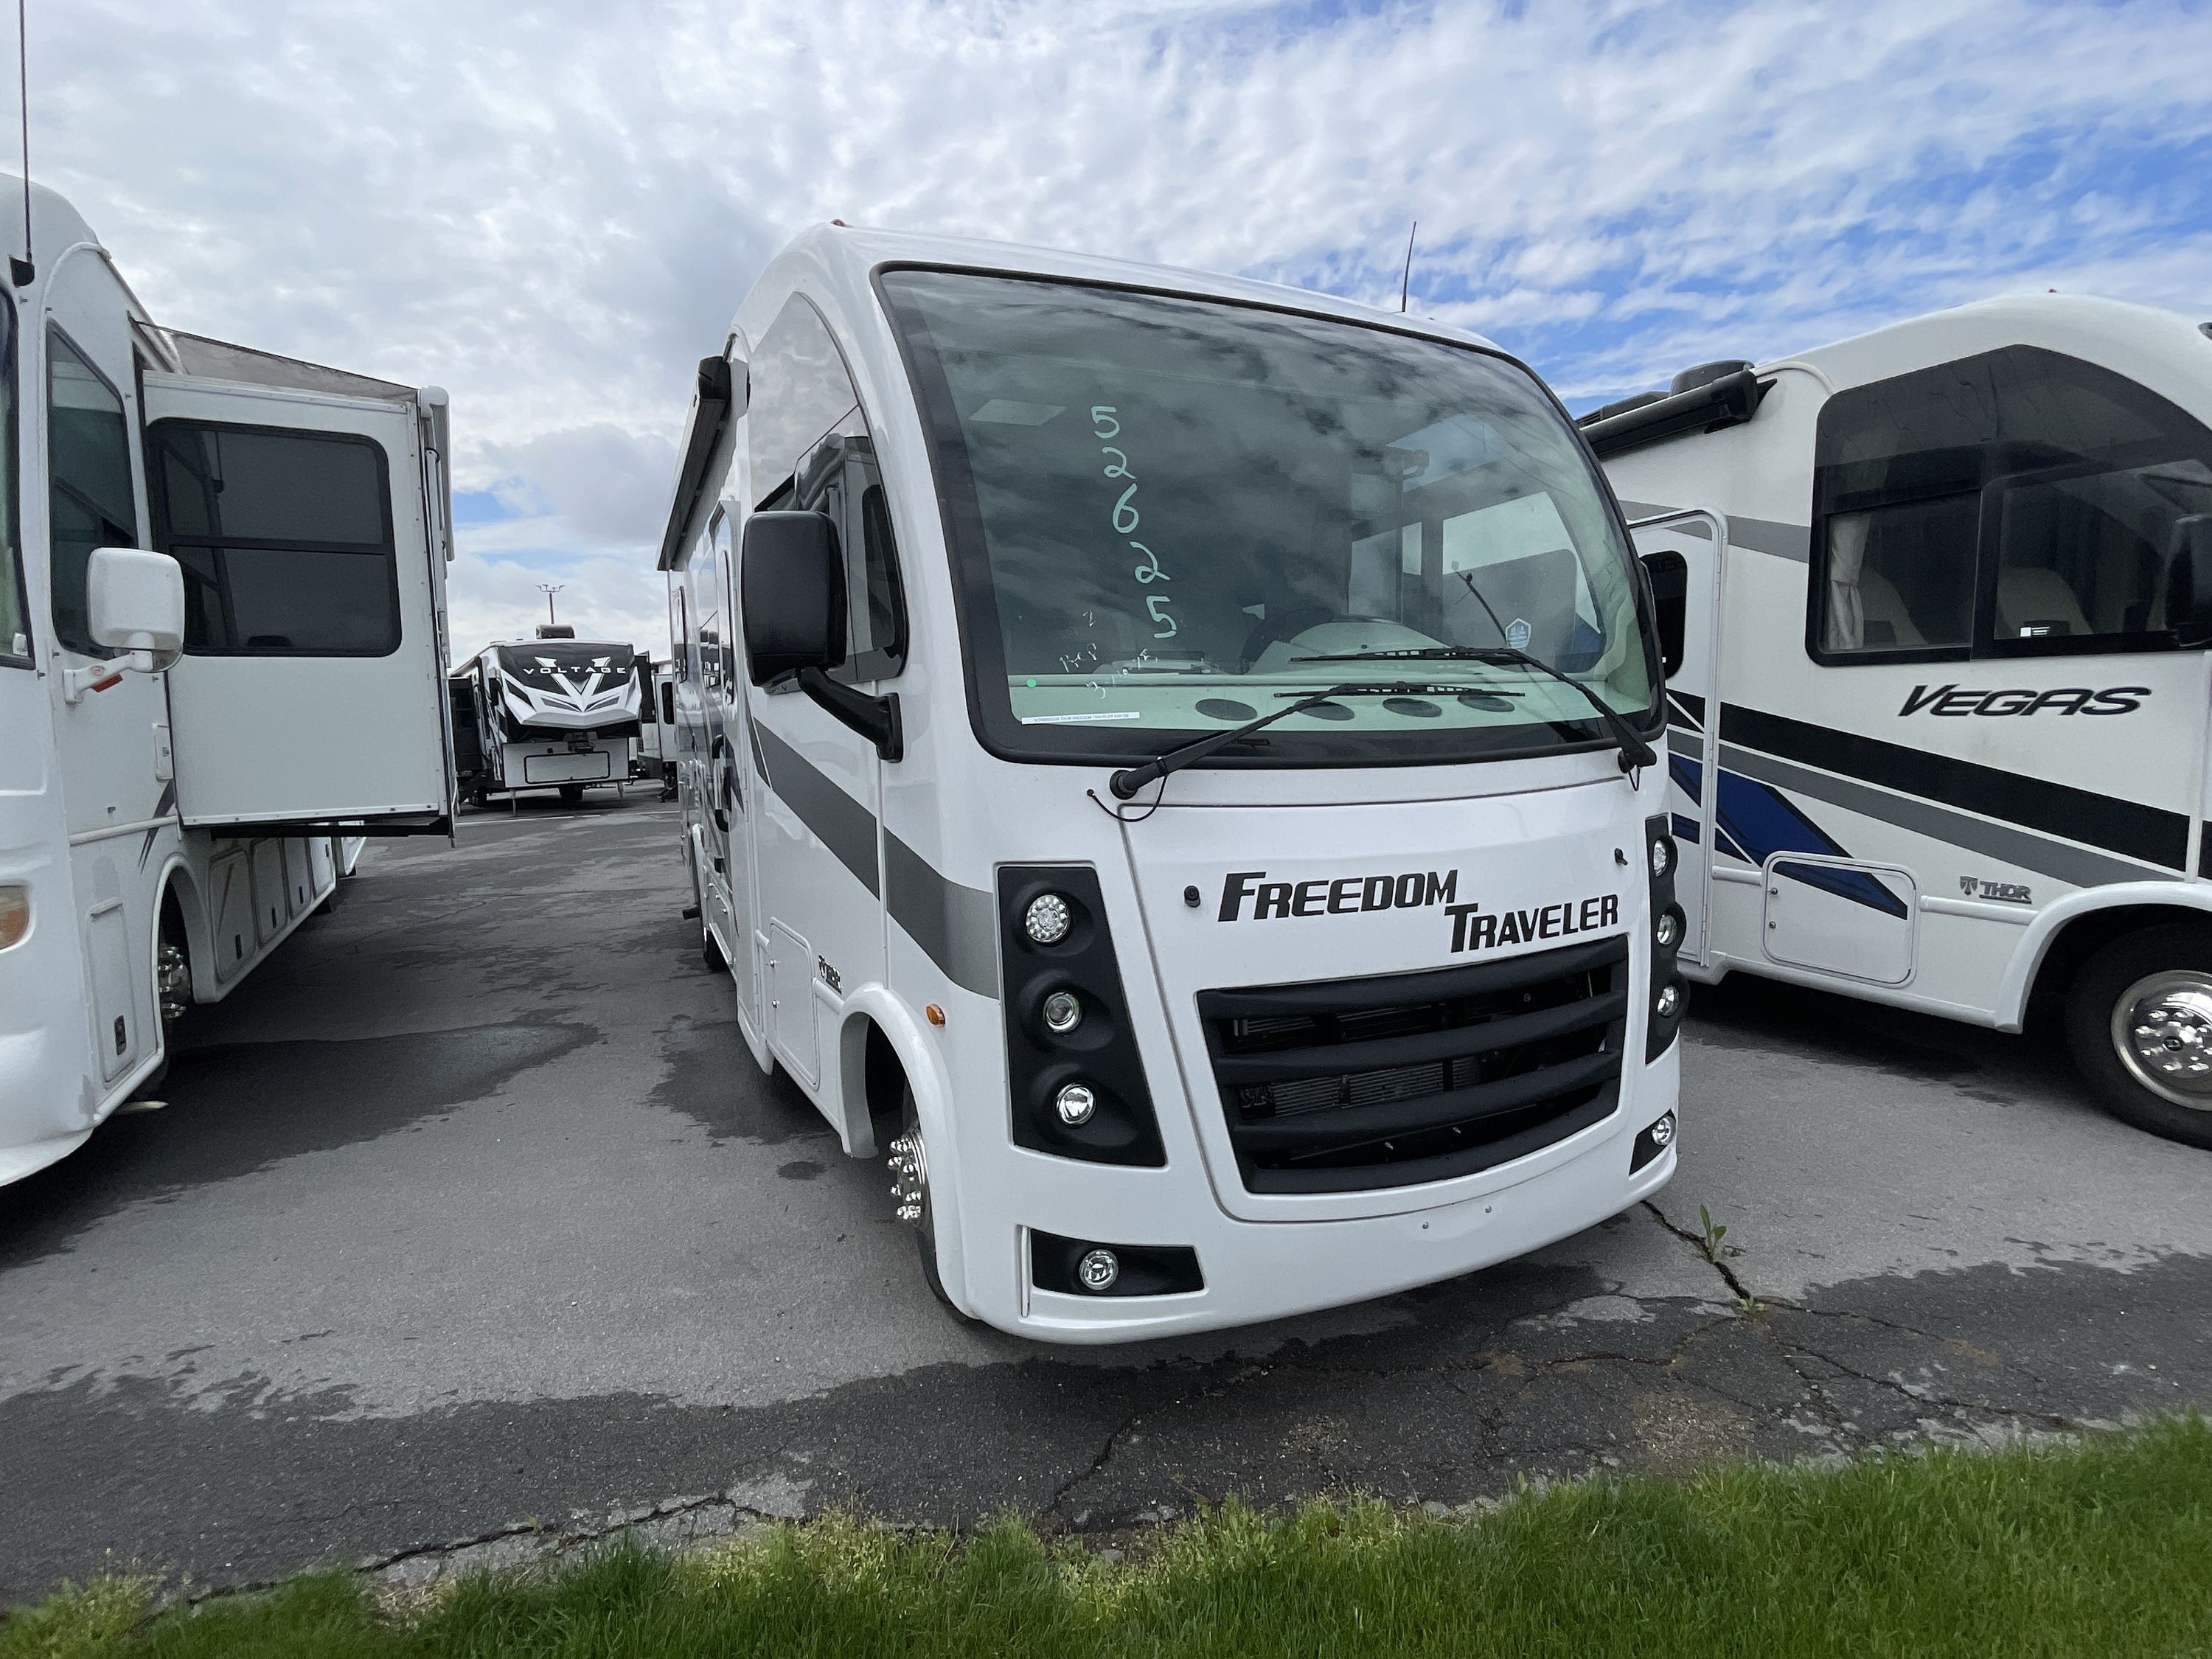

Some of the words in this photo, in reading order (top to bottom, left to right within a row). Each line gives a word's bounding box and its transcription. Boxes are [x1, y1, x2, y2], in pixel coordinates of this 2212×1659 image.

[1091, 406, 1177, 638] 52625
[1898, 684, 2152, 717] VEGAS
[1217, 869, 1458, 922] FREEDOM
[1979, 880, 2032, 902] THOR
[1444, 894, 1618, 953] TRAVELER
